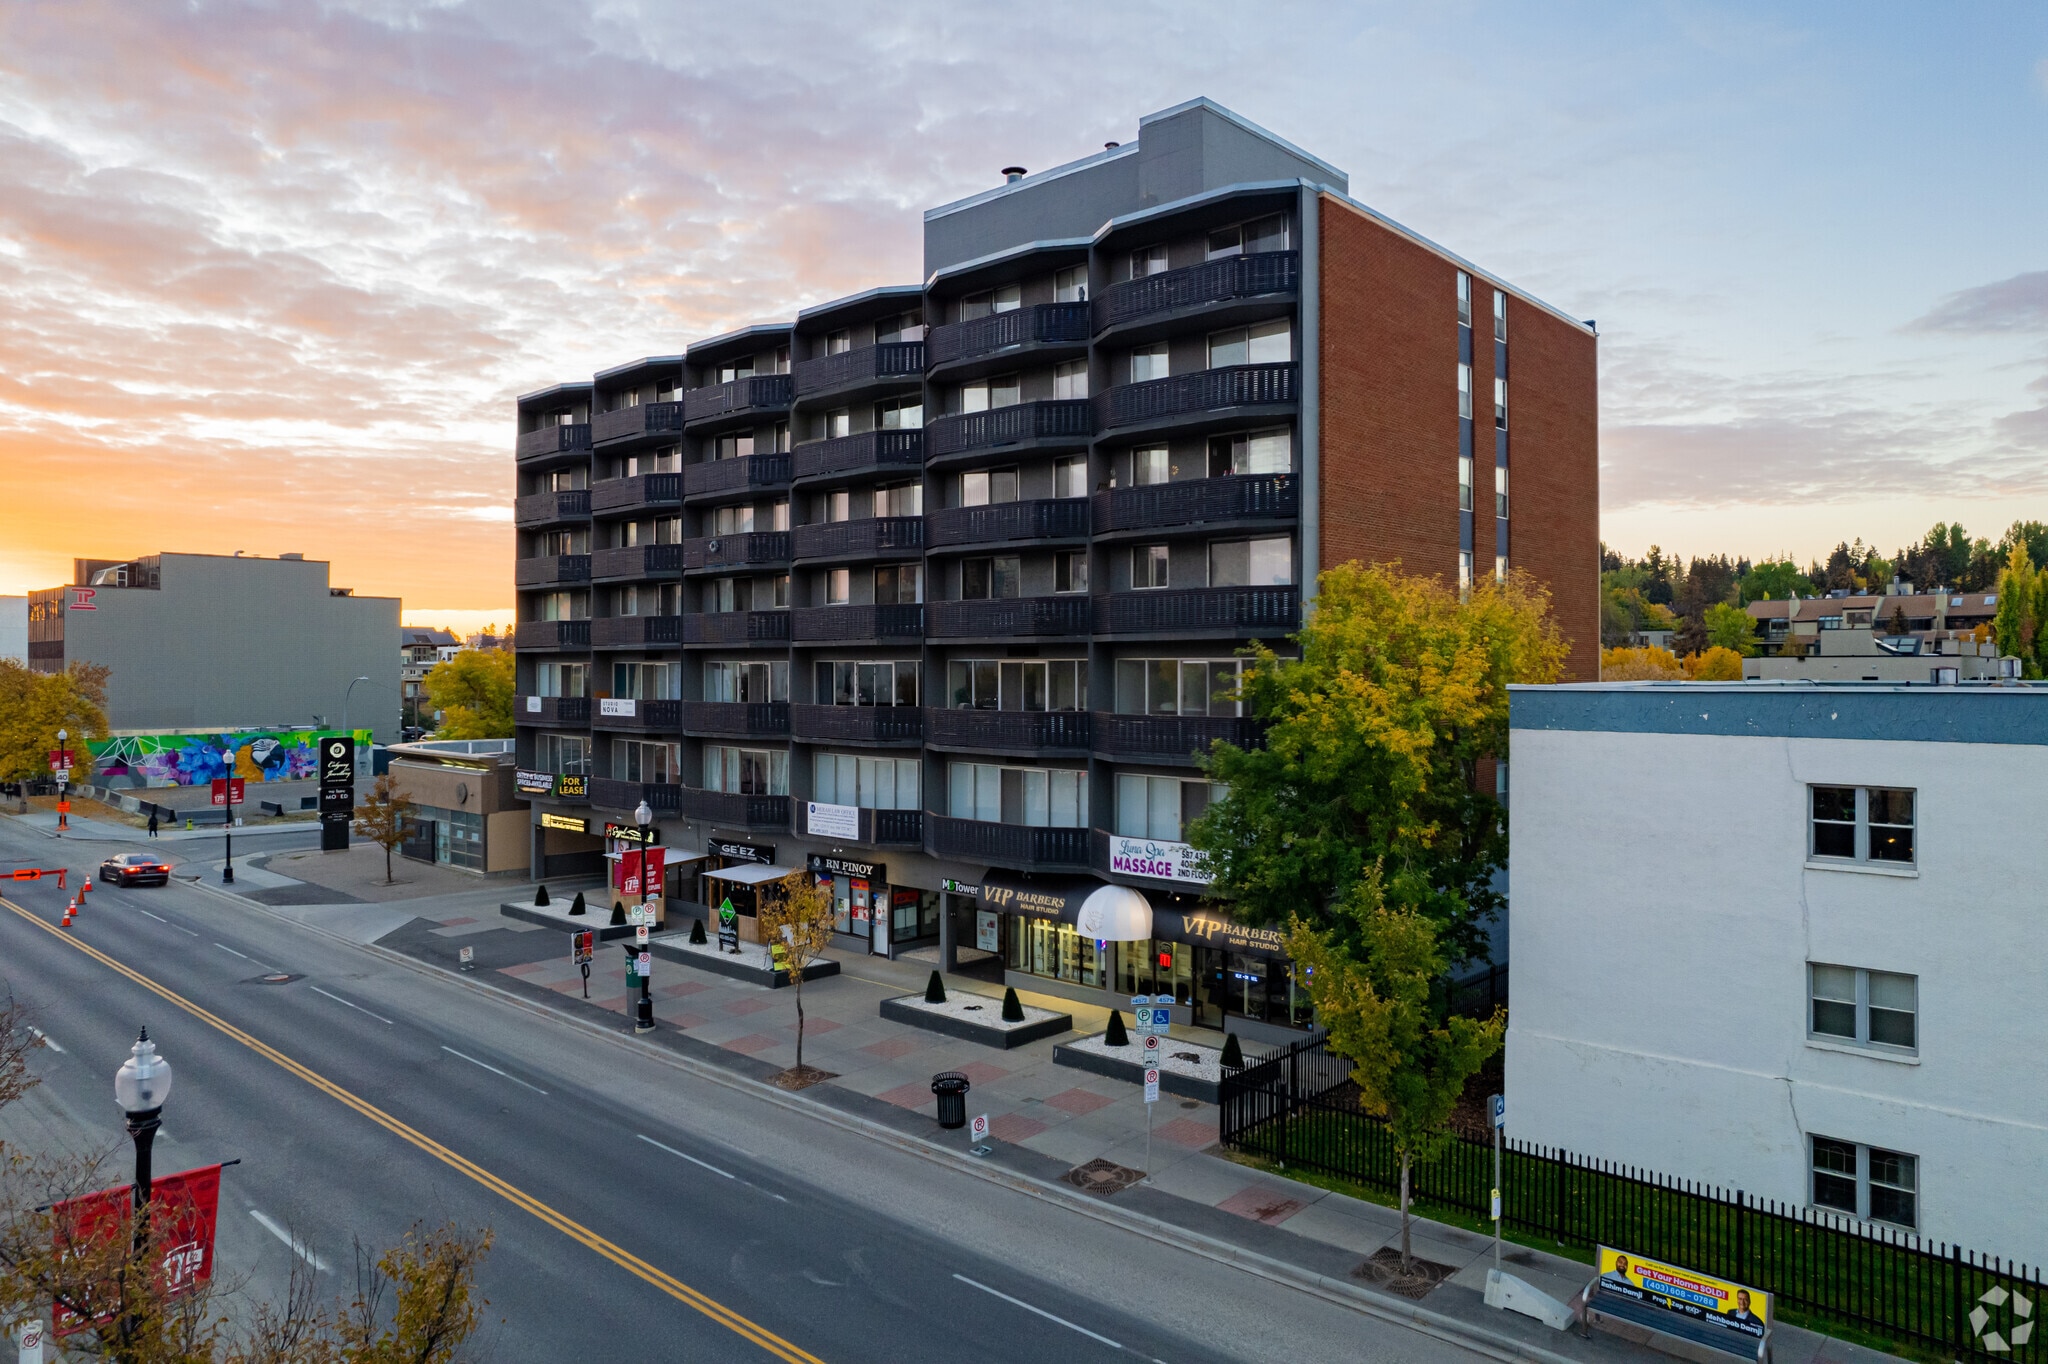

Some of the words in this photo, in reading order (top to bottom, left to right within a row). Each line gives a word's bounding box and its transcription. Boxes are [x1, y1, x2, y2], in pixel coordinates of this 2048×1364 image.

[559, 786, 584, 794] LEASE
[563, 777, 580, 786] FOR
[1119, 840, 1142, 858] Luna
[1145, 842, 1165, 860] Spa
[826, 859, 840, 870] RN
[842, 861, 873, 875] PINOY
[1114, 856, 1172, 876] MASSAGE
[1178, 868, 1190, 878] 2ND
[1191, 870, 1213, 880] FLOOR
[984, 885, 1014, 906] VIP
[1016, 891, 1066, 908] BARBERS
[1036, 906, 1059, 915] STUDIO
[1182, 916, 1222, 941] VIP
[1223, 923, 1286, 944] BARBERS
[1229, 937, 1247, 946] HAIR
[1250, 940, 1280, 951] STUDIO
[1601, 1281, 1622, 1292] Rahim
[1622, 1288, 1642, 1299] Damji
[1636, 1267, 1651, 1276] Get
[1652, 1271, 1672, 1282] Your
[1673, 1278, 1698, 1290] Home
[1700, 1285, 1726, 1299] SOLD!
[1646, 1279, 1669, 1294] (403)
[1670, 1287, 1686, 1298] 608
[1693, 1293, 1714, 1306] 0786
[1652, 1295, 1667, 1305] Prop
[1672, 1301, 1684, 1310] Zap
[1706, 1313, 1739, 1328] Mehboob
[1740, 1324, 1763, 1336] Damji
